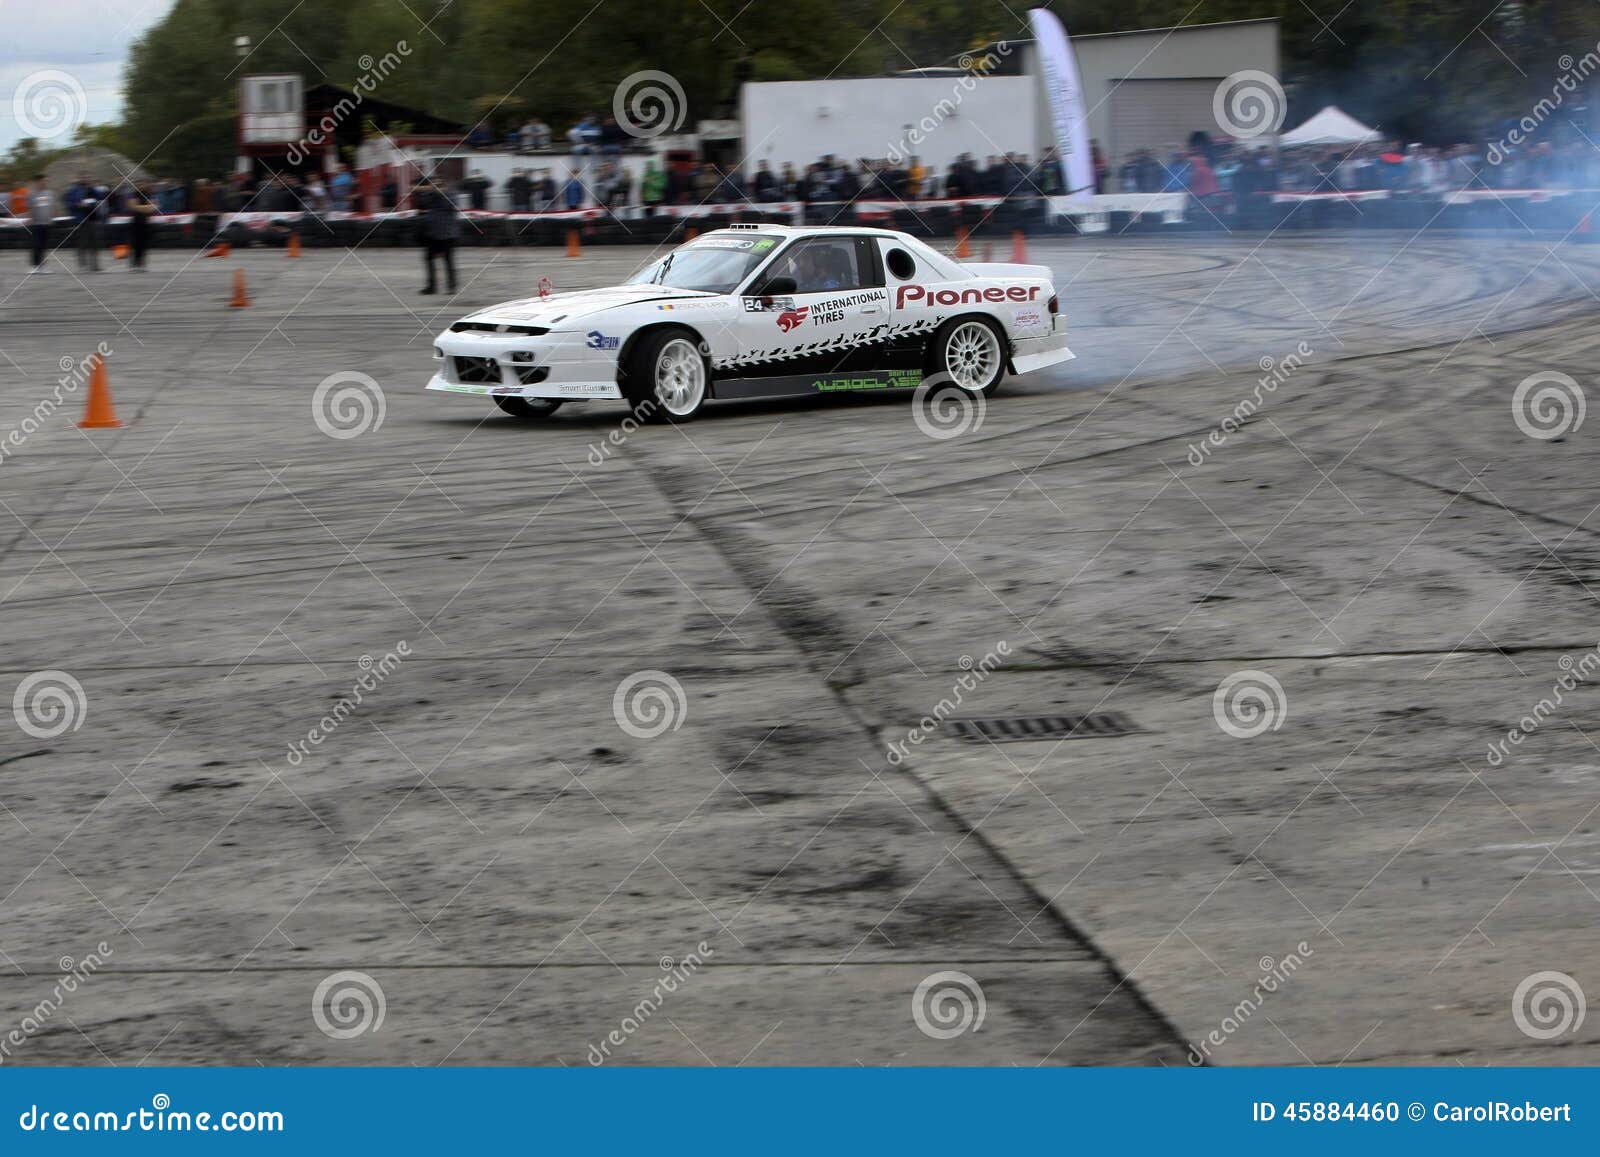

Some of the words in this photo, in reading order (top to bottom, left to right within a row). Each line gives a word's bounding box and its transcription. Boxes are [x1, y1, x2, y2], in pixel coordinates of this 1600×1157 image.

[745, 299, 763, 311] 24
[811, 290, 886, 315] INTERNATIONAL
[896, 284, 1041, 310] Pioneer
[813, 309, 845, 326] TYRES
